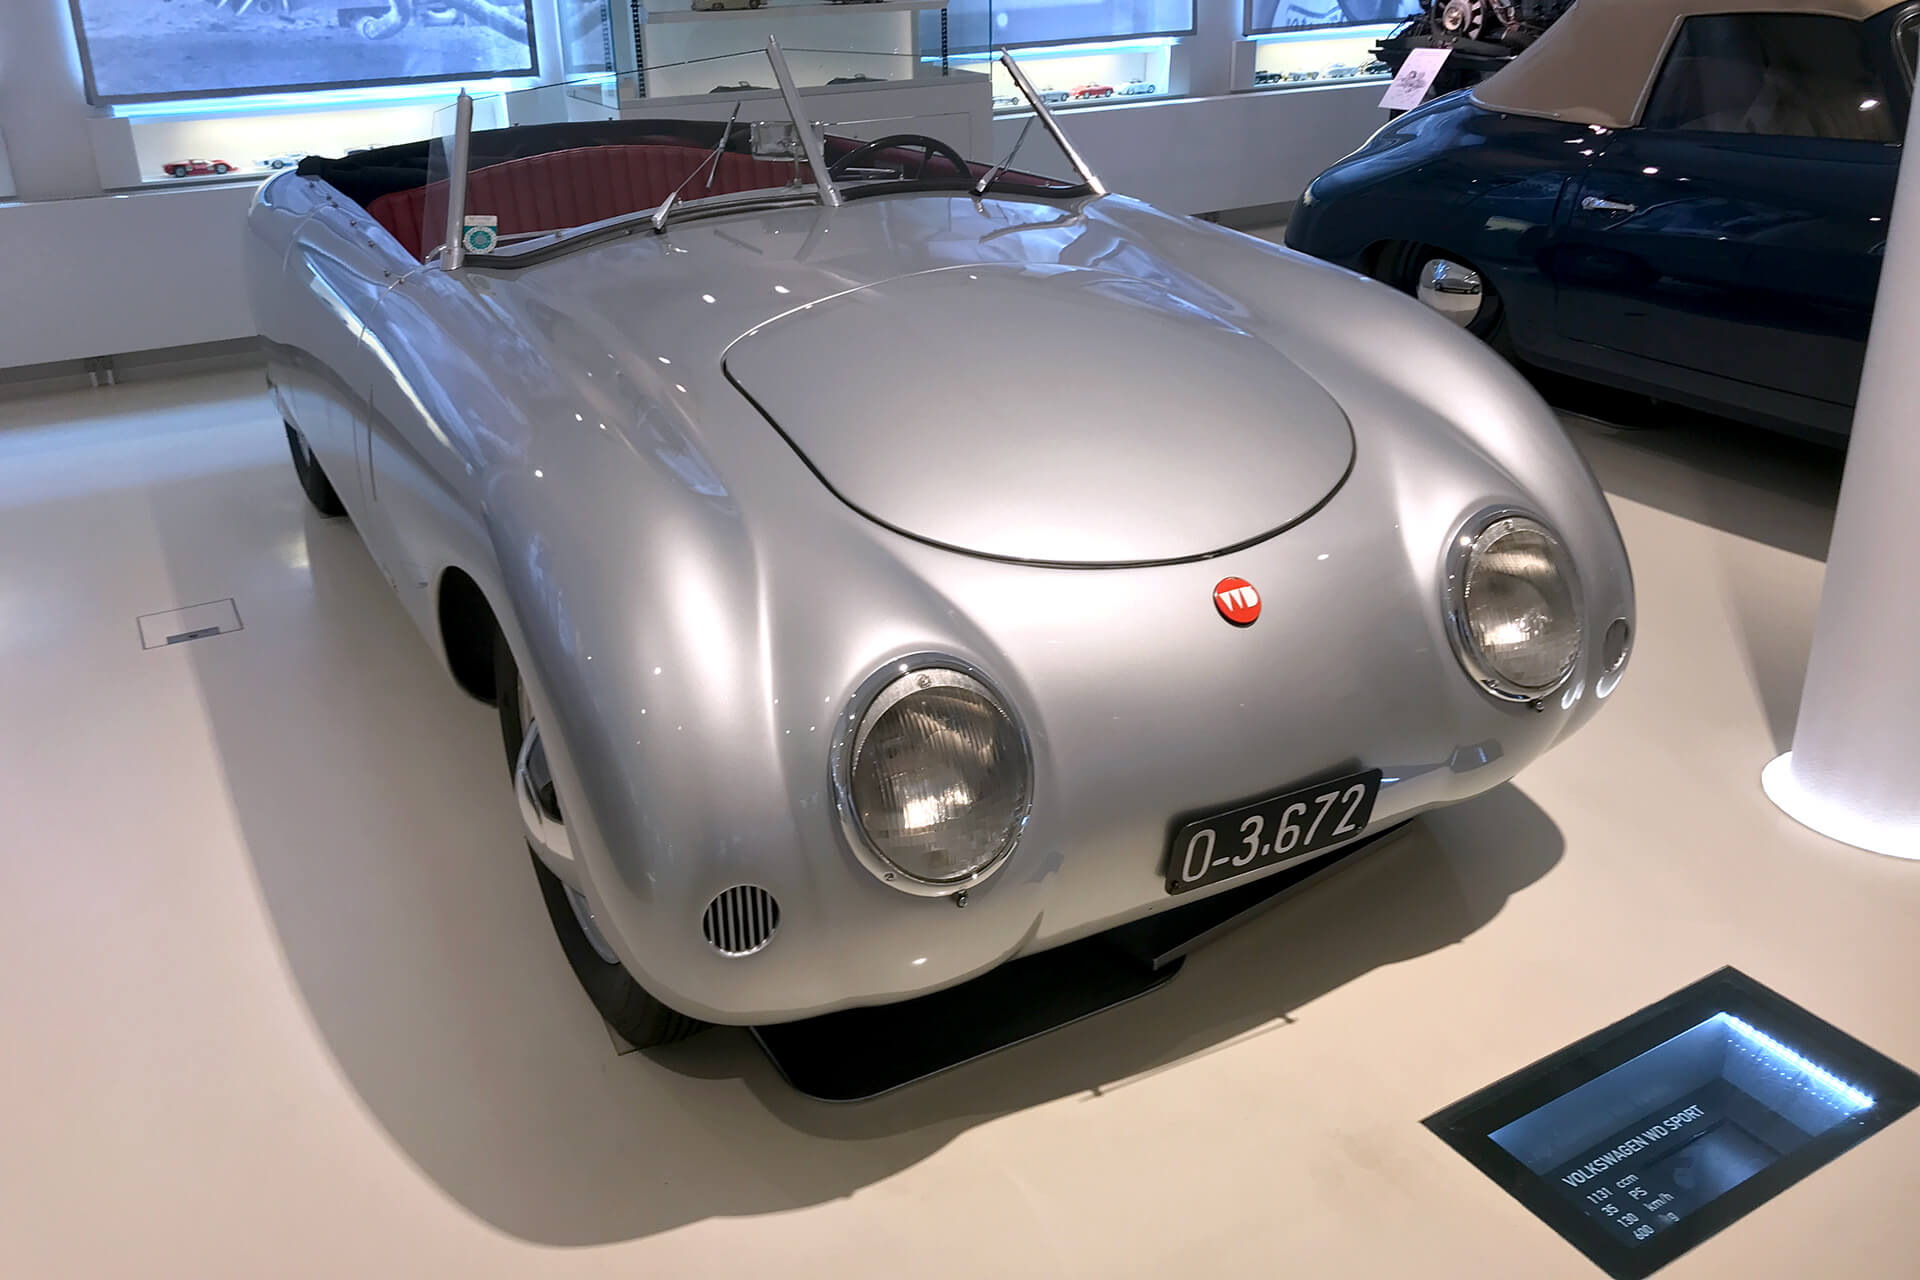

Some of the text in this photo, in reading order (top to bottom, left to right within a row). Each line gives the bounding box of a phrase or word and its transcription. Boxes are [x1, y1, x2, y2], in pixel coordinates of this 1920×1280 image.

[1561, 1104, 1705, 1188] VOLKSWAGEN WD SPORT
[1586, 1173, 1640, 1205] 1131 ccm
[1601, 1186, 1649, 1217] 35 PS
[1617, 1192, 1675, 1228] 130 km/h
[1632, 1224, 1656, 1241] 600
